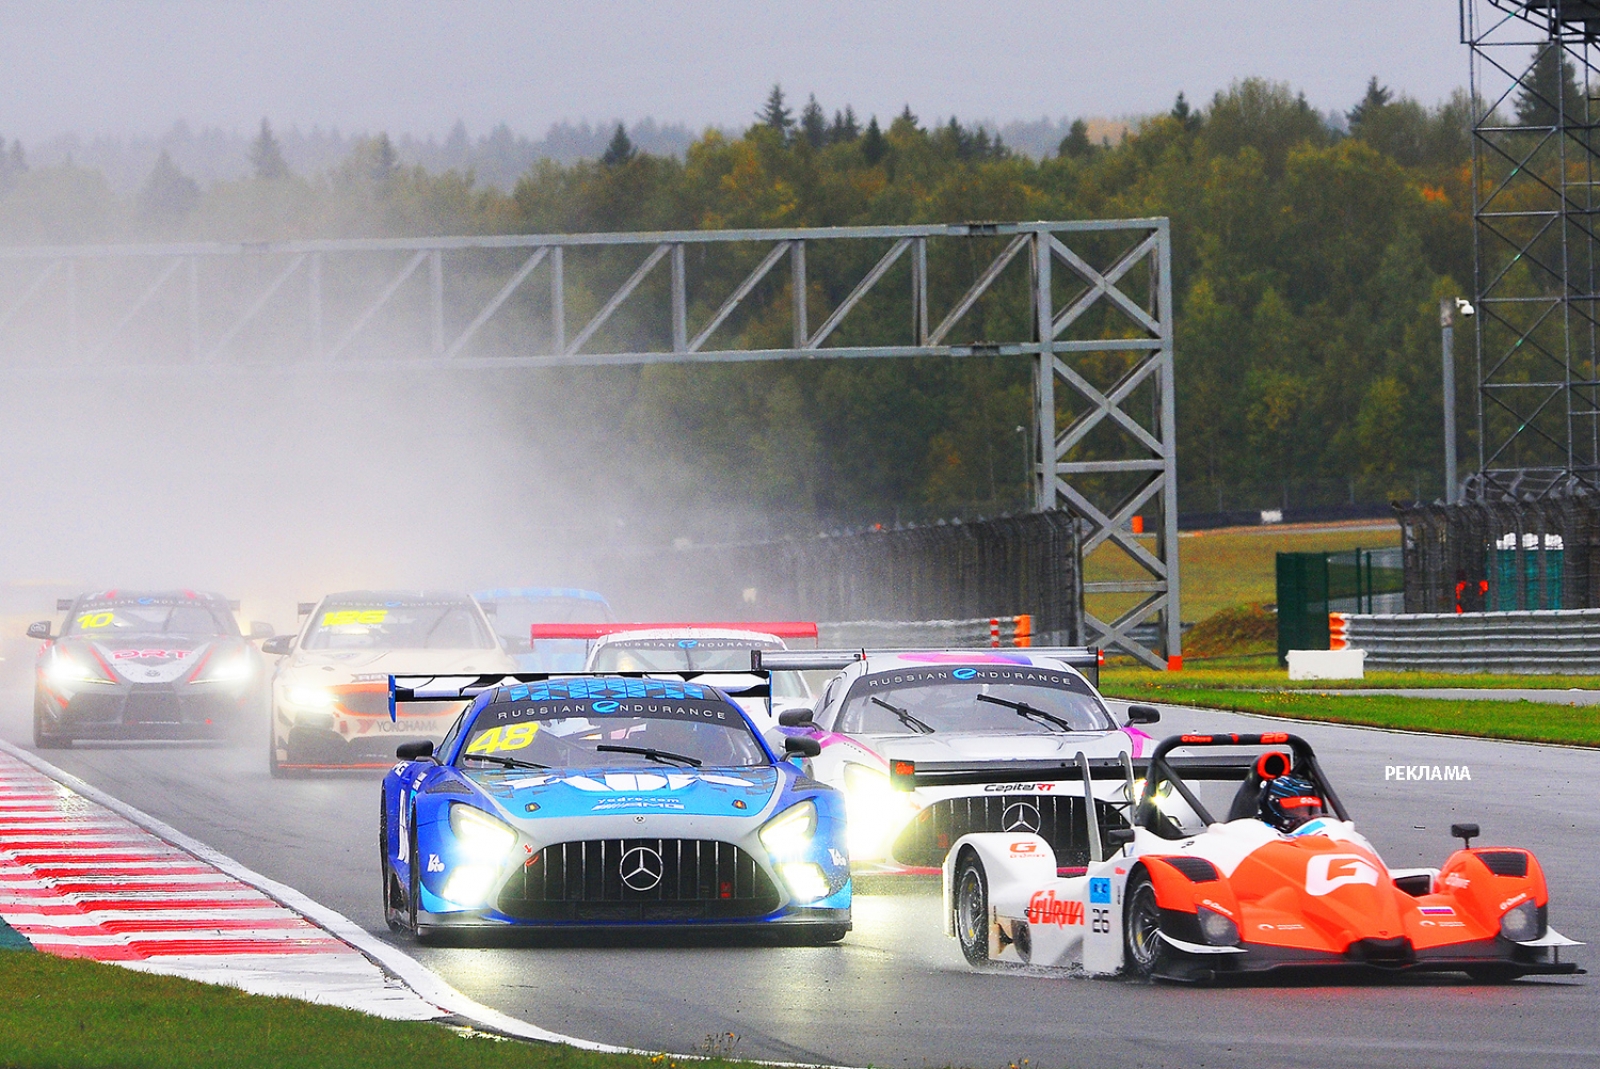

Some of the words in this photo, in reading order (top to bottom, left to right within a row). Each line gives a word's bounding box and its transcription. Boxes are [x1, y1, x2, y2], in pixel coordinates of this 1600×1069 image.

[77, 612, 115, 629] 10
[321, 610, 388, 627] 126
[111, 649, 193, 660] DRT
[869, 672, 947, 687] RUSSIAN
[497, 704, 586, 720] RUSSIAN
[376, 720, 437, 733] YOKOHAMA
[465, 722, 539, 754] 48
[1260, 733, 1289, 743] 26
[1305, 853, 1379, 896] G
[1092, 908, 1110, 933] 26
